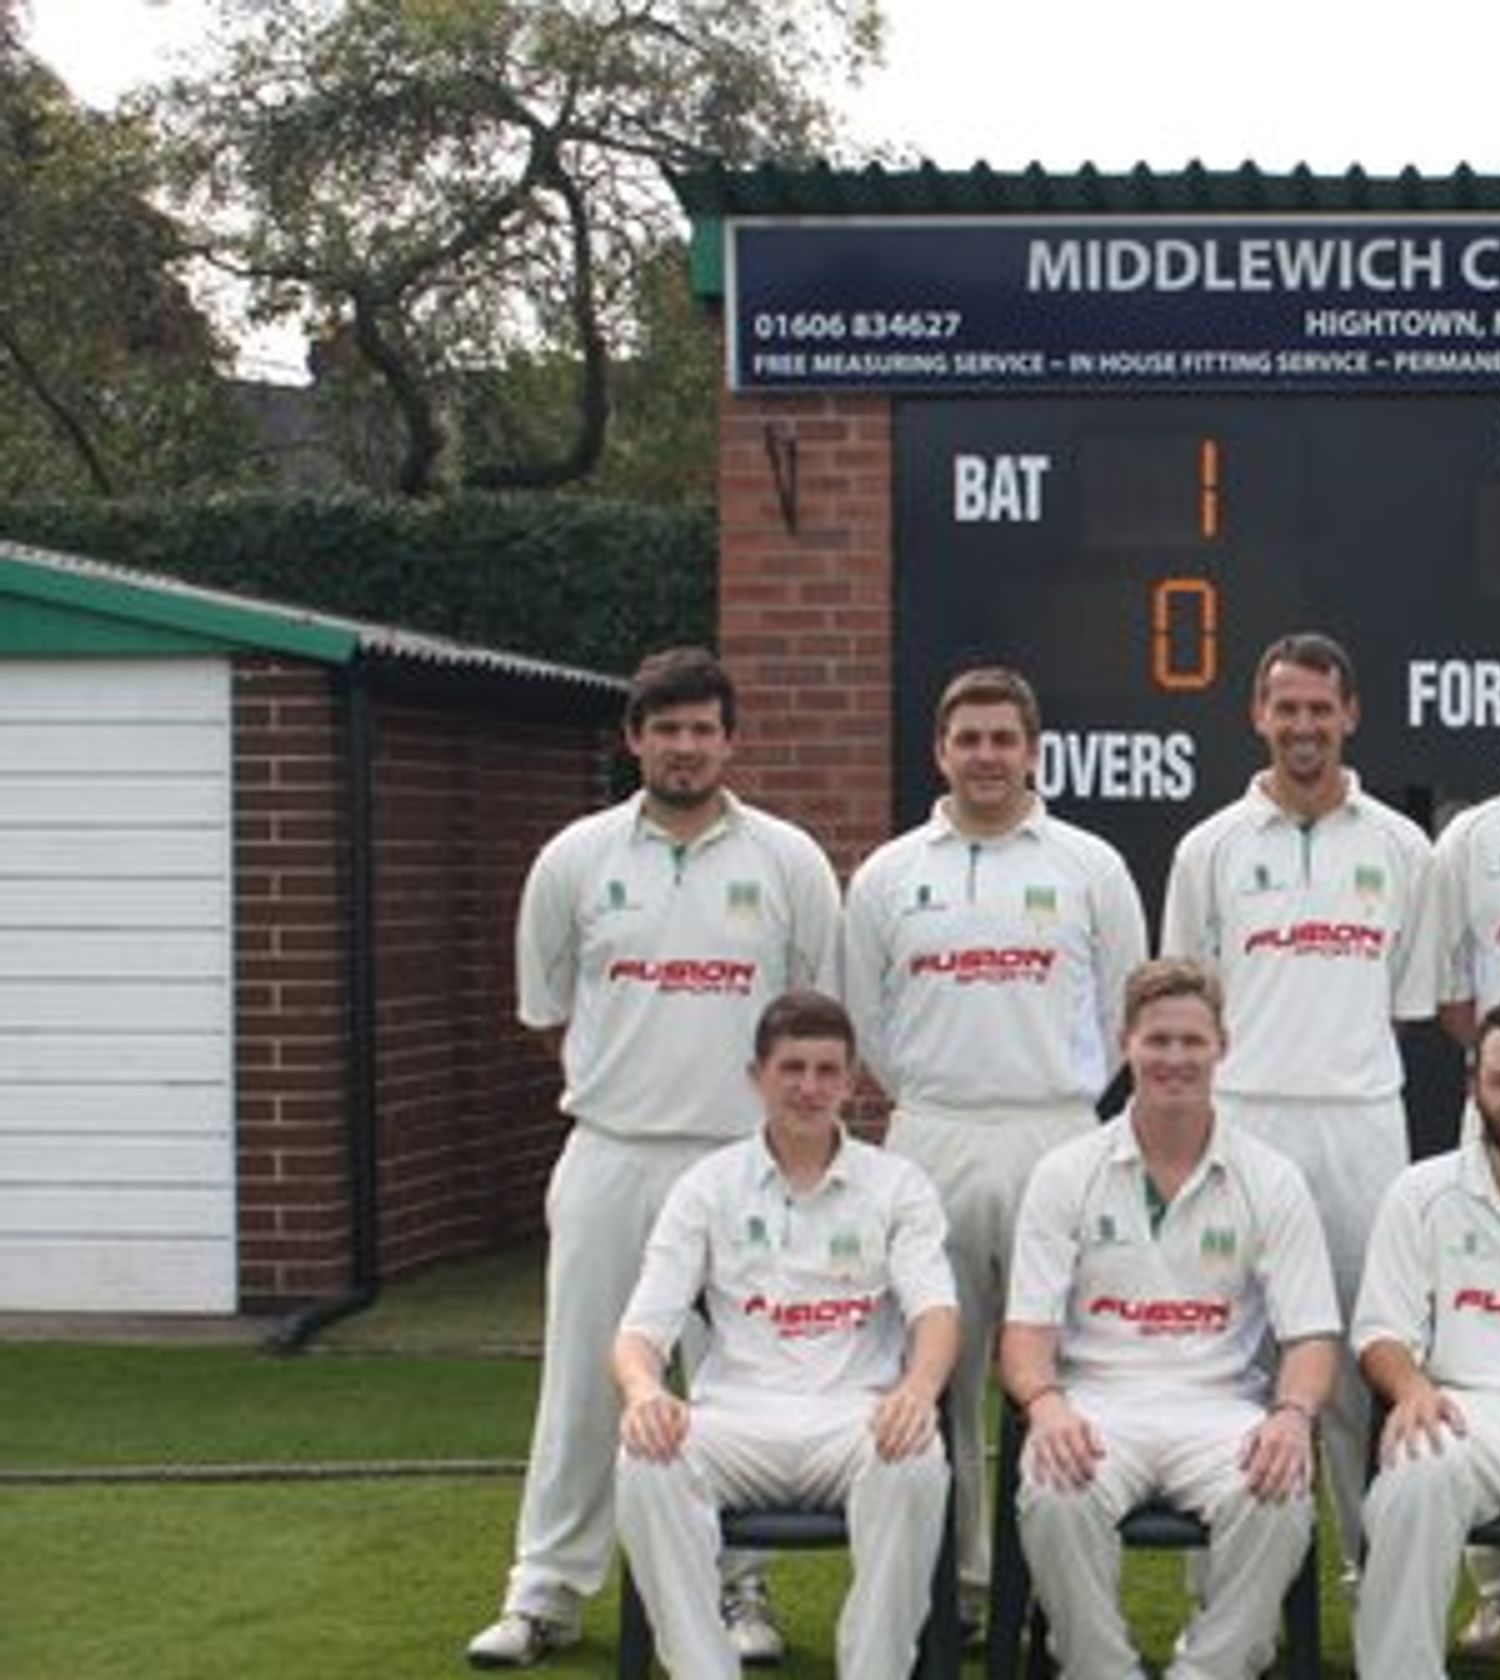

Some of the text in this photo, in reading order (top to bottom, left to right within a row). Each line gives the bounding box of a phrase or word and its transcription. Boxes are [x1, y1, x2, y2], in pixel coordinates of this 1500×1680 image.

[1028, 238, 1443, 292] MIDDLEWICH
[754, 312, 961, 338] 01606 834627
[1305, 310, 1486, 339] HIGHTOWN,
[754, 354, 806, 375] FREE
[813, 354, 947, 375] MEASURING
[953, 353, 1043, 374] SERVICE
[1069, 353, 1094, 373] IN
[1100, 352, 1176, 374] HOUSE
[1182, 352, 1271, 374] FITTING
[1275, 351, 1368, 373] SERVICE
[954, 455, 1050, 522] BAT
[1200, 438, 1217, 534] 1
[1152, 578, 1217, 690] 0
[1036, 731, 1195, 799] OVERS
